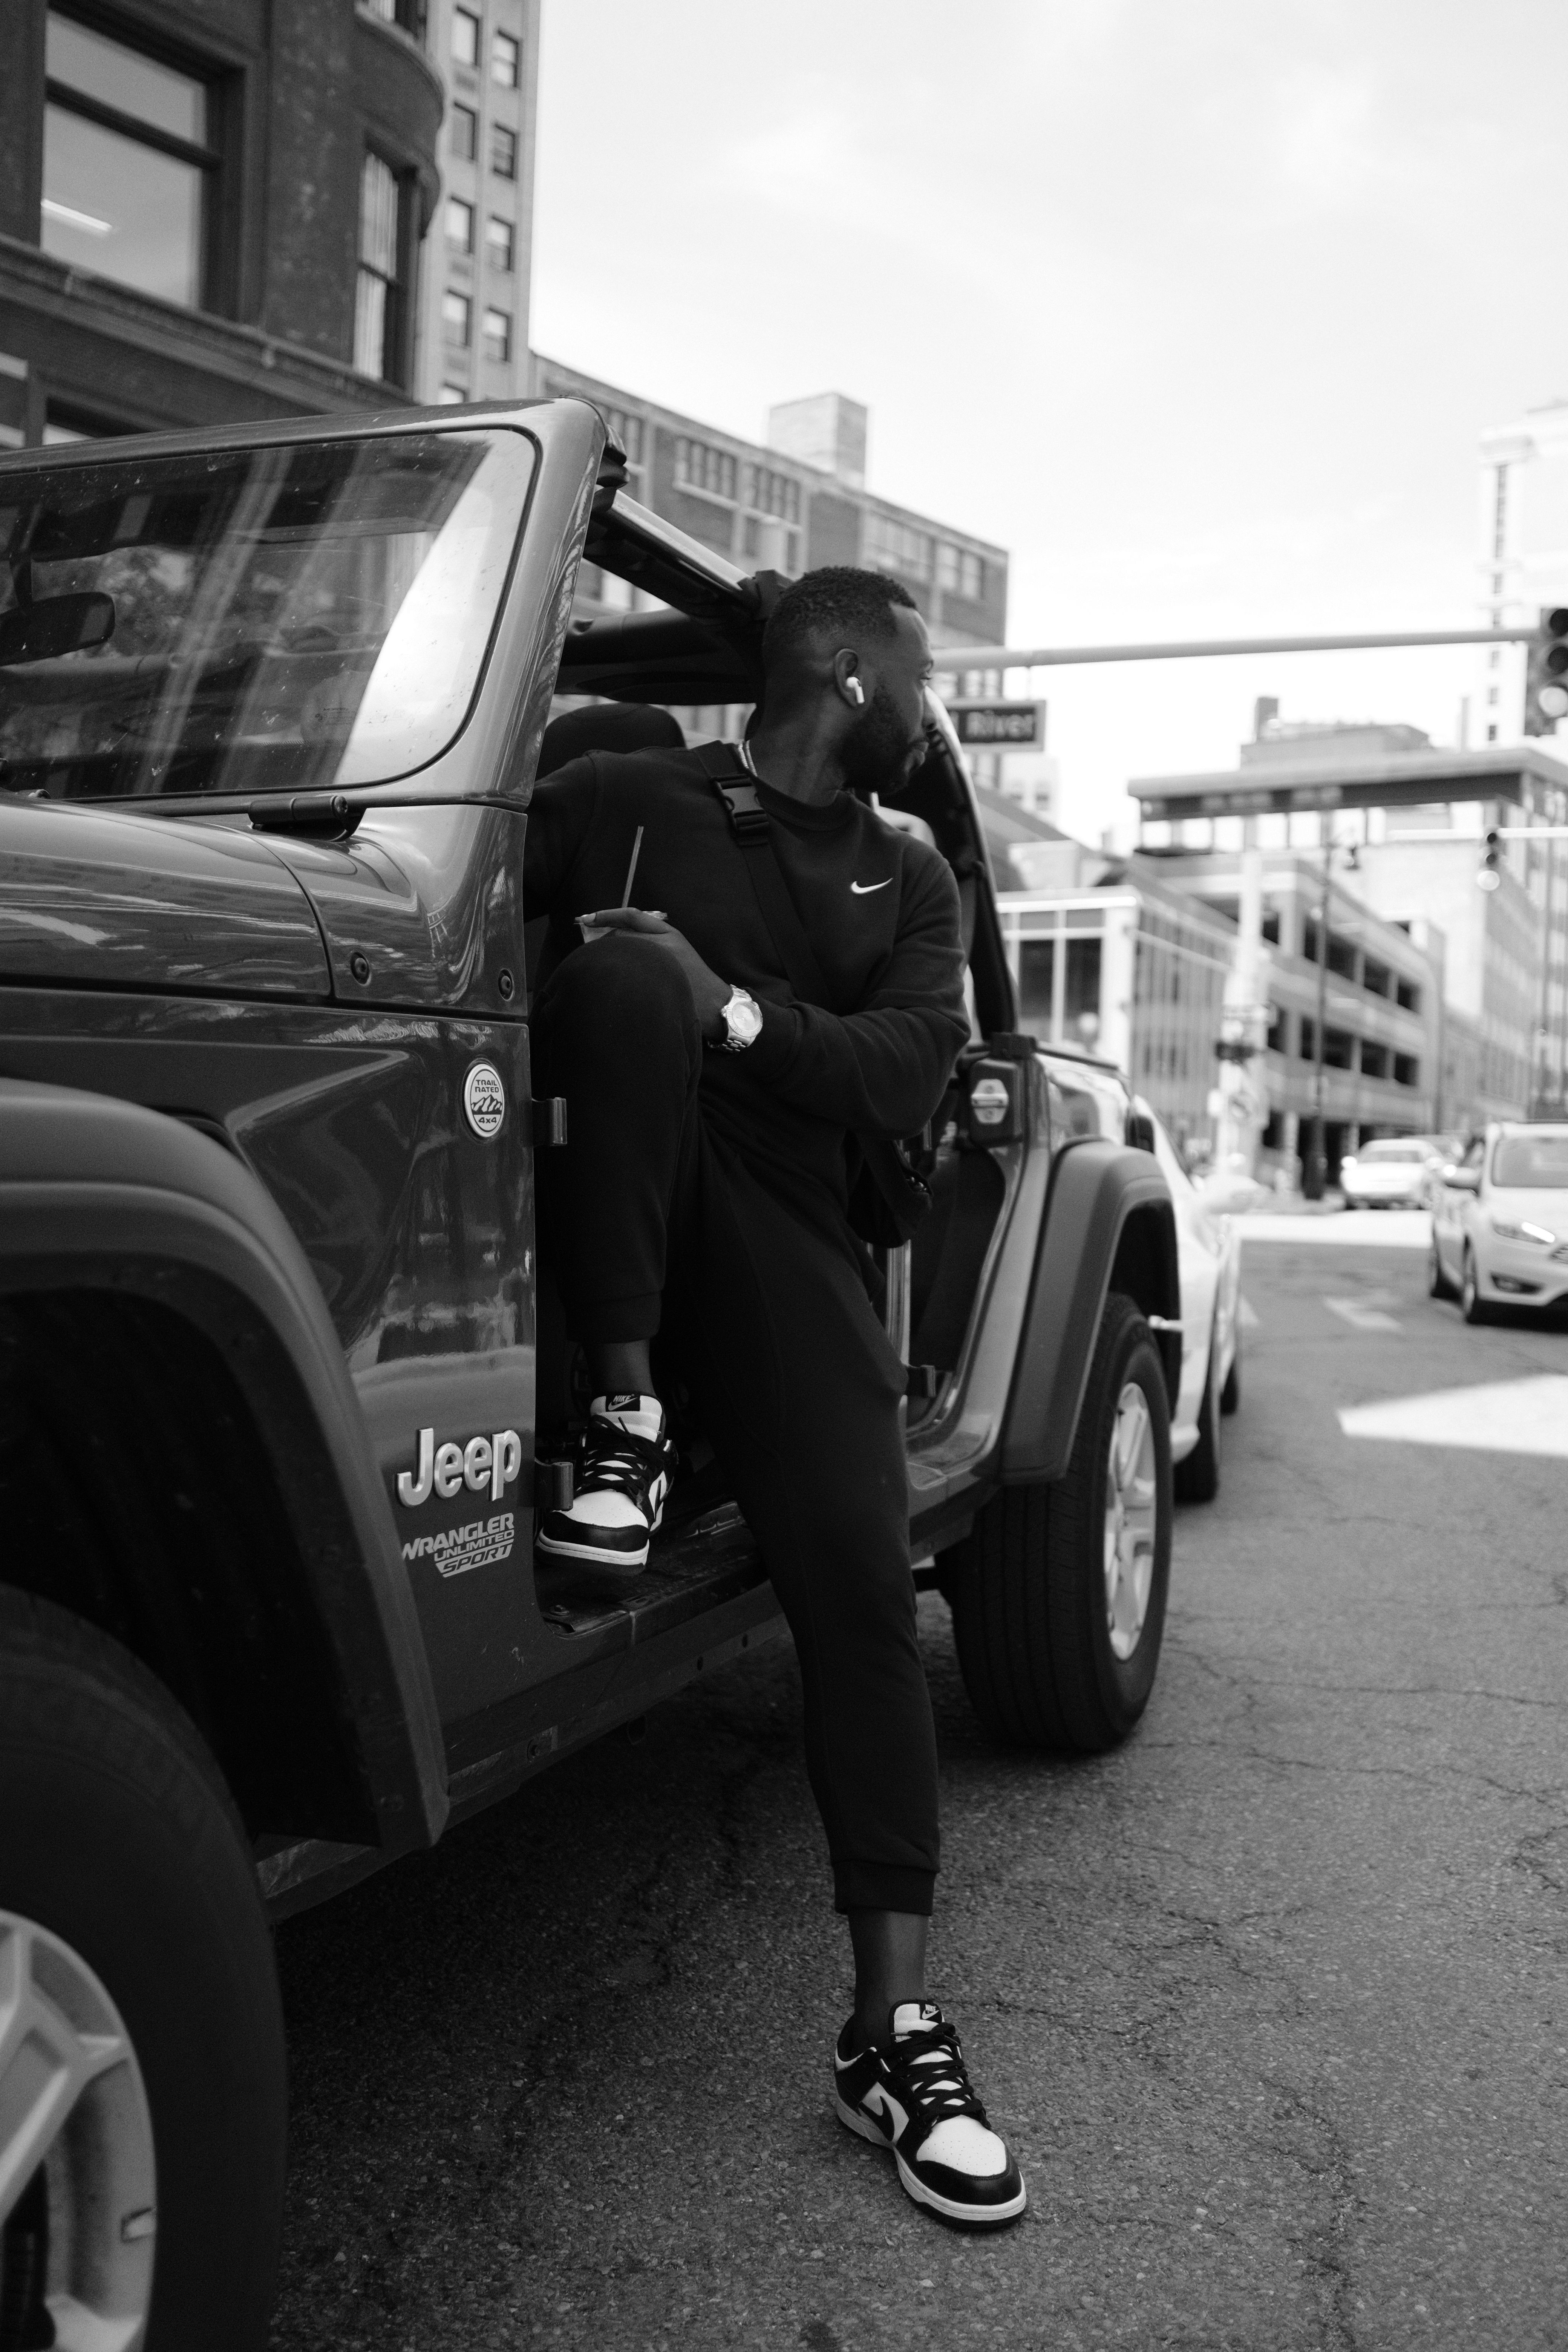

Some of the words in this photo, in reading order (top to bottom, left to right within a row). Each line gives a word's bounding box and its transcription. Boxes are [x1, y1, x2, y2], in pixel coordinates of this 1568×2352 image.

[397, 1428, 521, 1506] Jeep
[435, 1530, 514, 1562] UNLIMITED
[443, 1547, 510, 1573] SPORT
